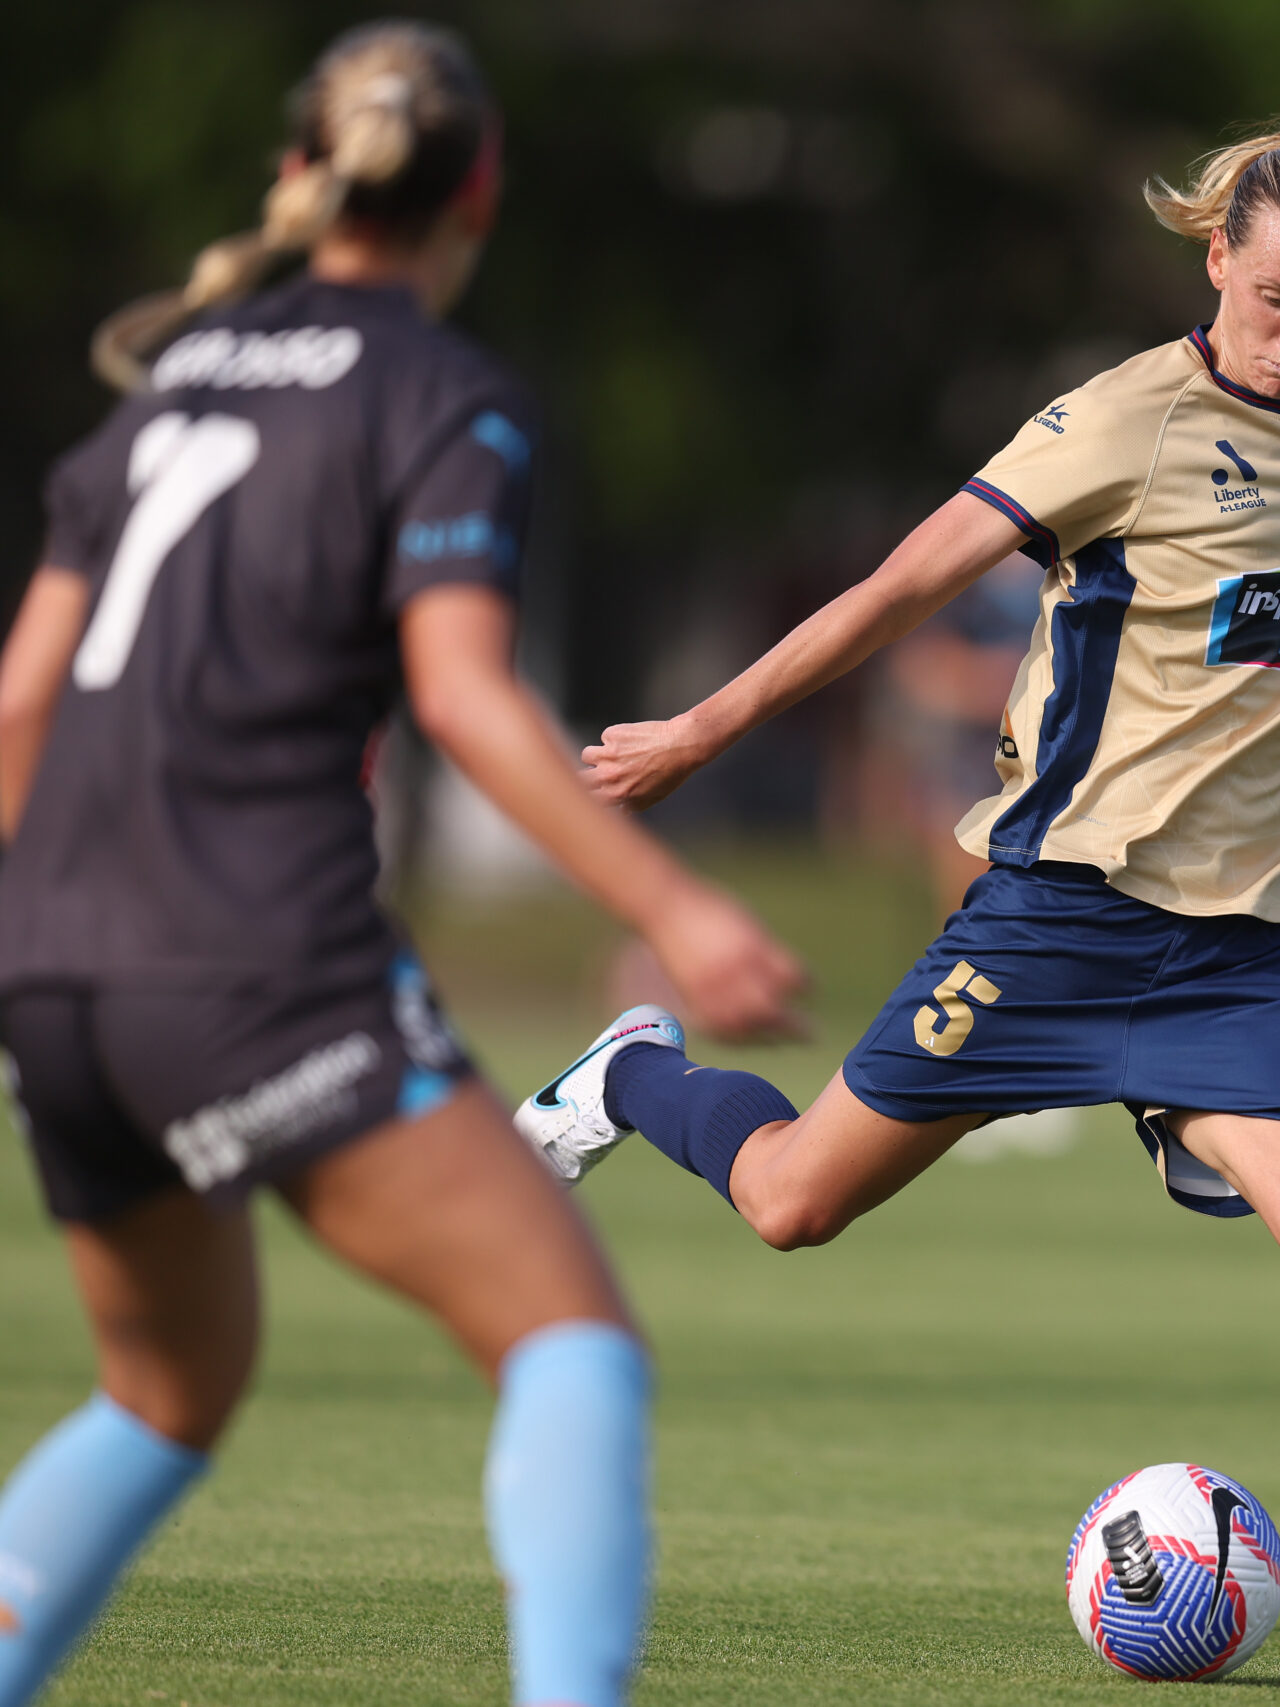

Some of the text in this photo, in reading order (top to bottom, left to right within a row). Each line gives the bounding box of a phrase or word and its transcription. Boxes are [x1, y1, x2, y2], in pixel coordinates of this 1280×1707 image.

[1214, 487, 1260, 503] Liberty
[1220, 499, 1267, 513] A-LEAGUE
[73, 411, 261, 691] 7
[913, 960, 1002, 1056] 5
